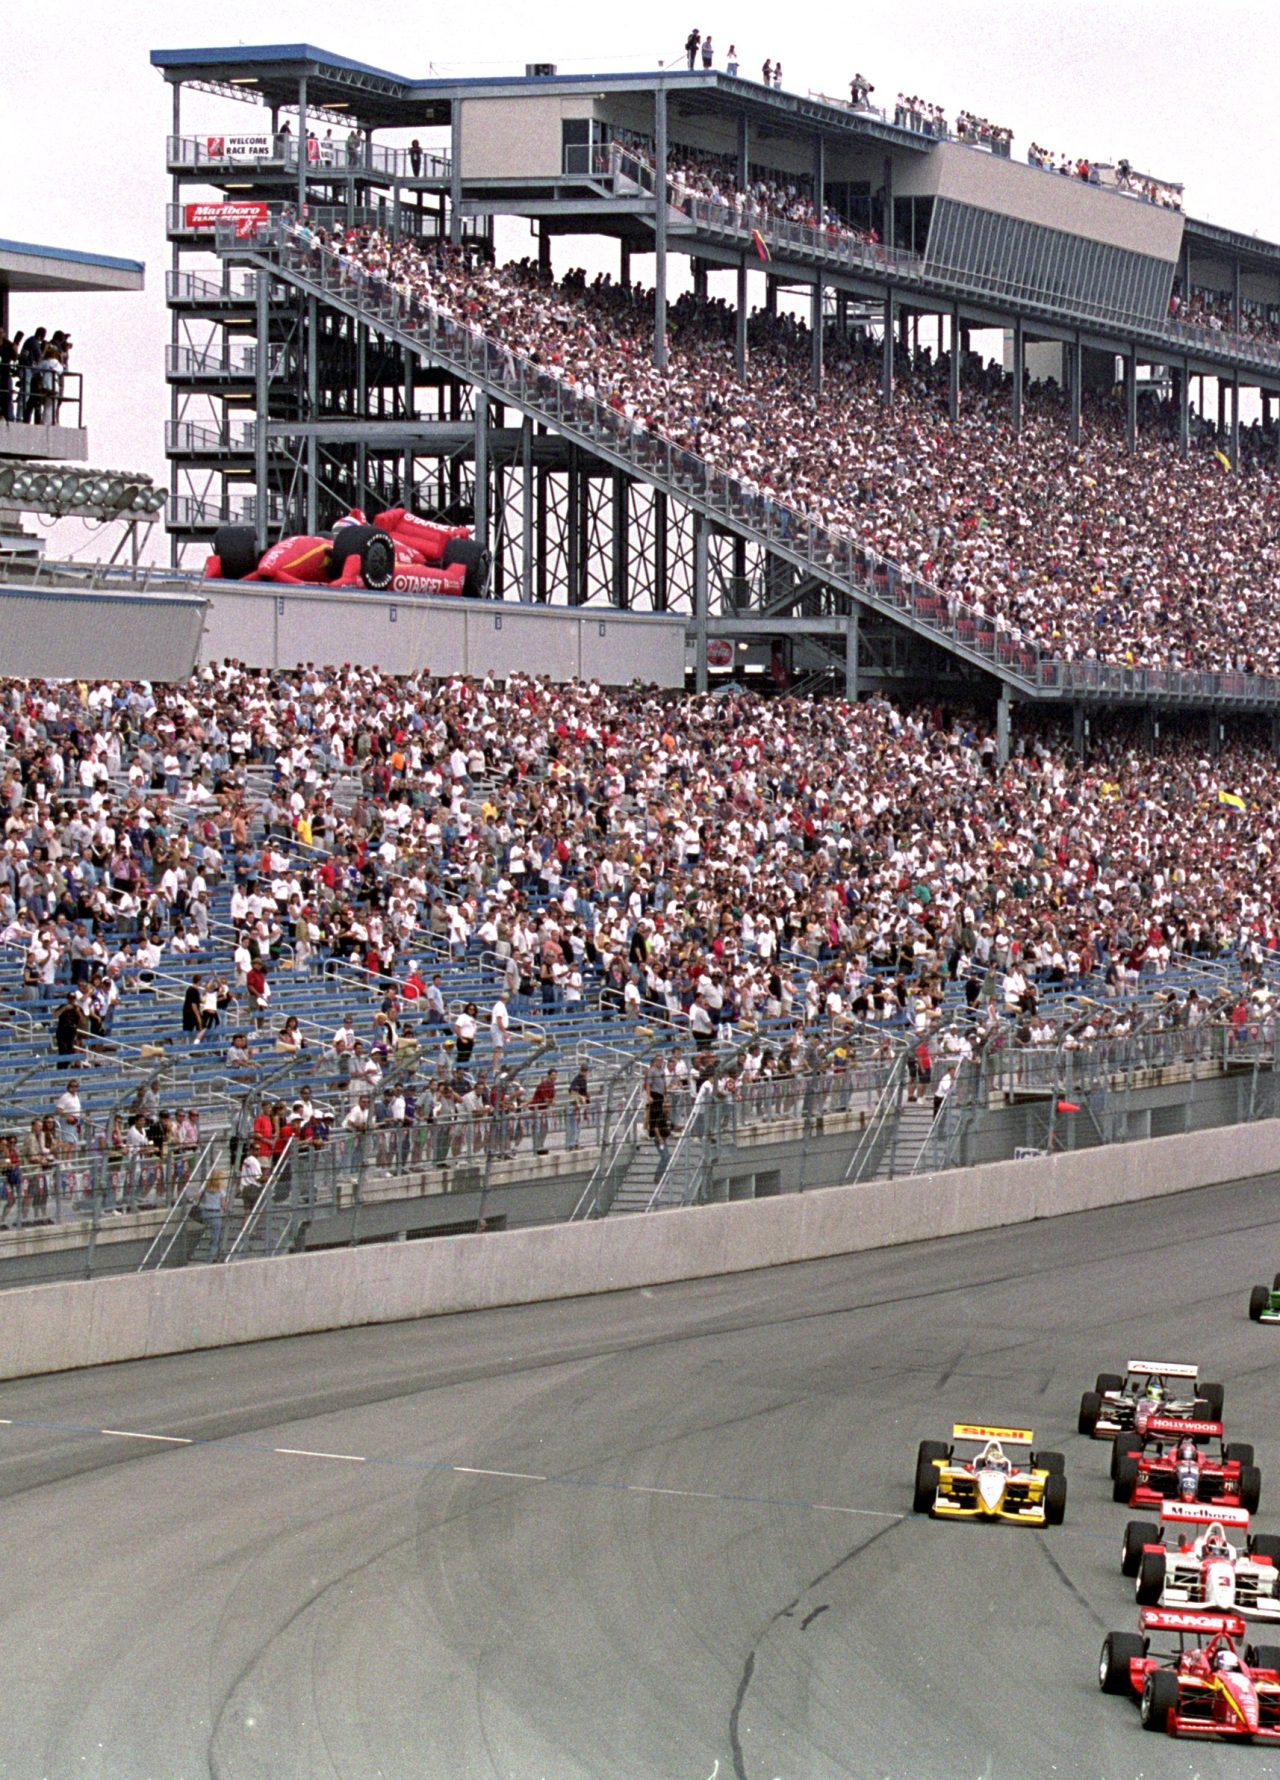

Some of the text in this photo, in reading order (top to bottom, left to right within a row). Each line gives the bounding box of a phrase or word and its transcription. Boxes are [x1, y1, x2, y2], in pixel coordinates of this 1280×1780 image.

[229, 137, 267, 145] WELCOME
[226, 147, 269, 155] RACE FANS
[194, 206, 260, 216] Marlboro
[413, 516, 458, 532] TARGET
[407, 575, 442, 593] TARGET
[1153, 1419, 1217, 1431] HOLLYWOOD
[962, 1427, 1024, 1439] Shell
[1171, 1506, 1237, 1520] Marlboro
[1218, 1576, 1231, 1587] 3
[1159, 1612, 1236, 1629] TARGET
